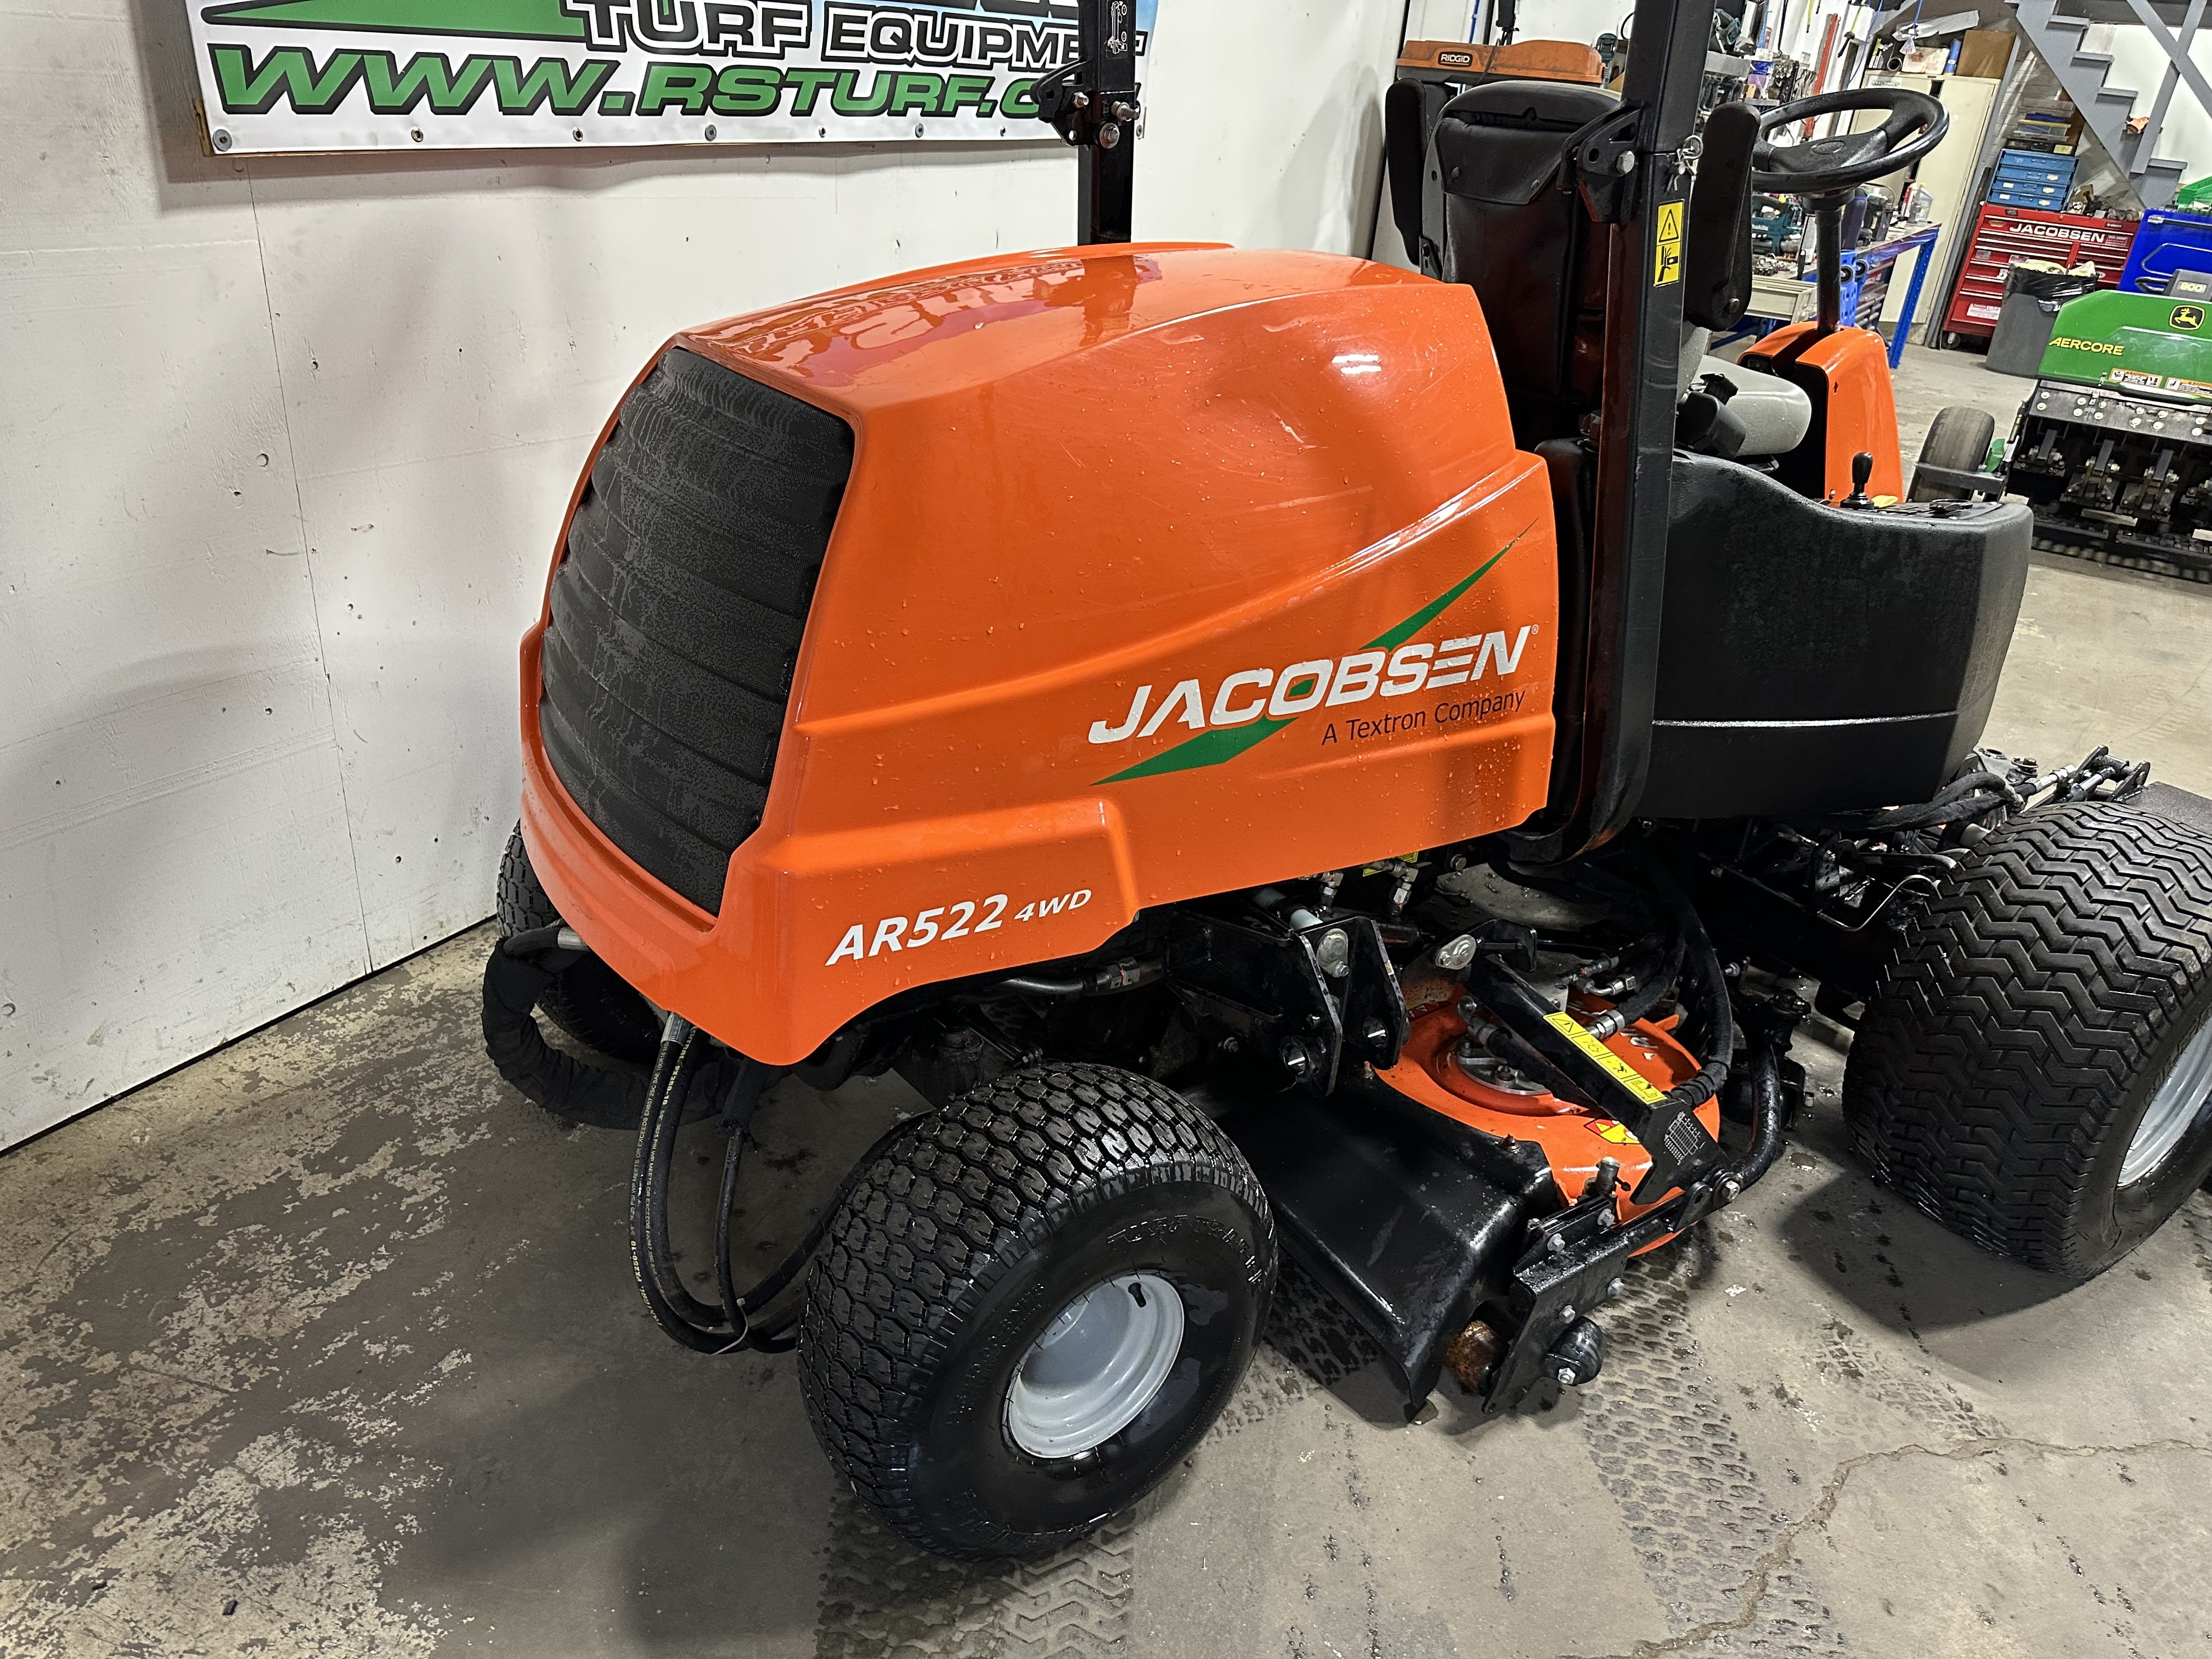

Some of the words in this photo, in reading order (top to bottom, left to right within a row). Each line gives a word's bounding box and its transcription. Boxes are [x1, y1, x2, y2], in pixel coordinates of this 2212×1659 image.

[565, 0, 812, 58] TURF
[1440, 53, 1470, 63] RIDGID
[2009, 222, 2106, 244] JACOBSEN
[2049, 337, 2124, 356] AERCORE
[1321, 720, 1338, 746] A
[1346, 709, 1426, 742] Textron
[1434, 690, 1526, 723] Company
[825, 894, 1008, 967] AR522
[1013, 889, 1092, 922] 4WD
[637, 1117, 648, 1148] EXCEEDS
[636, 1148, 642, 1159] OR
[646, 1187, 651, 1197] OR
